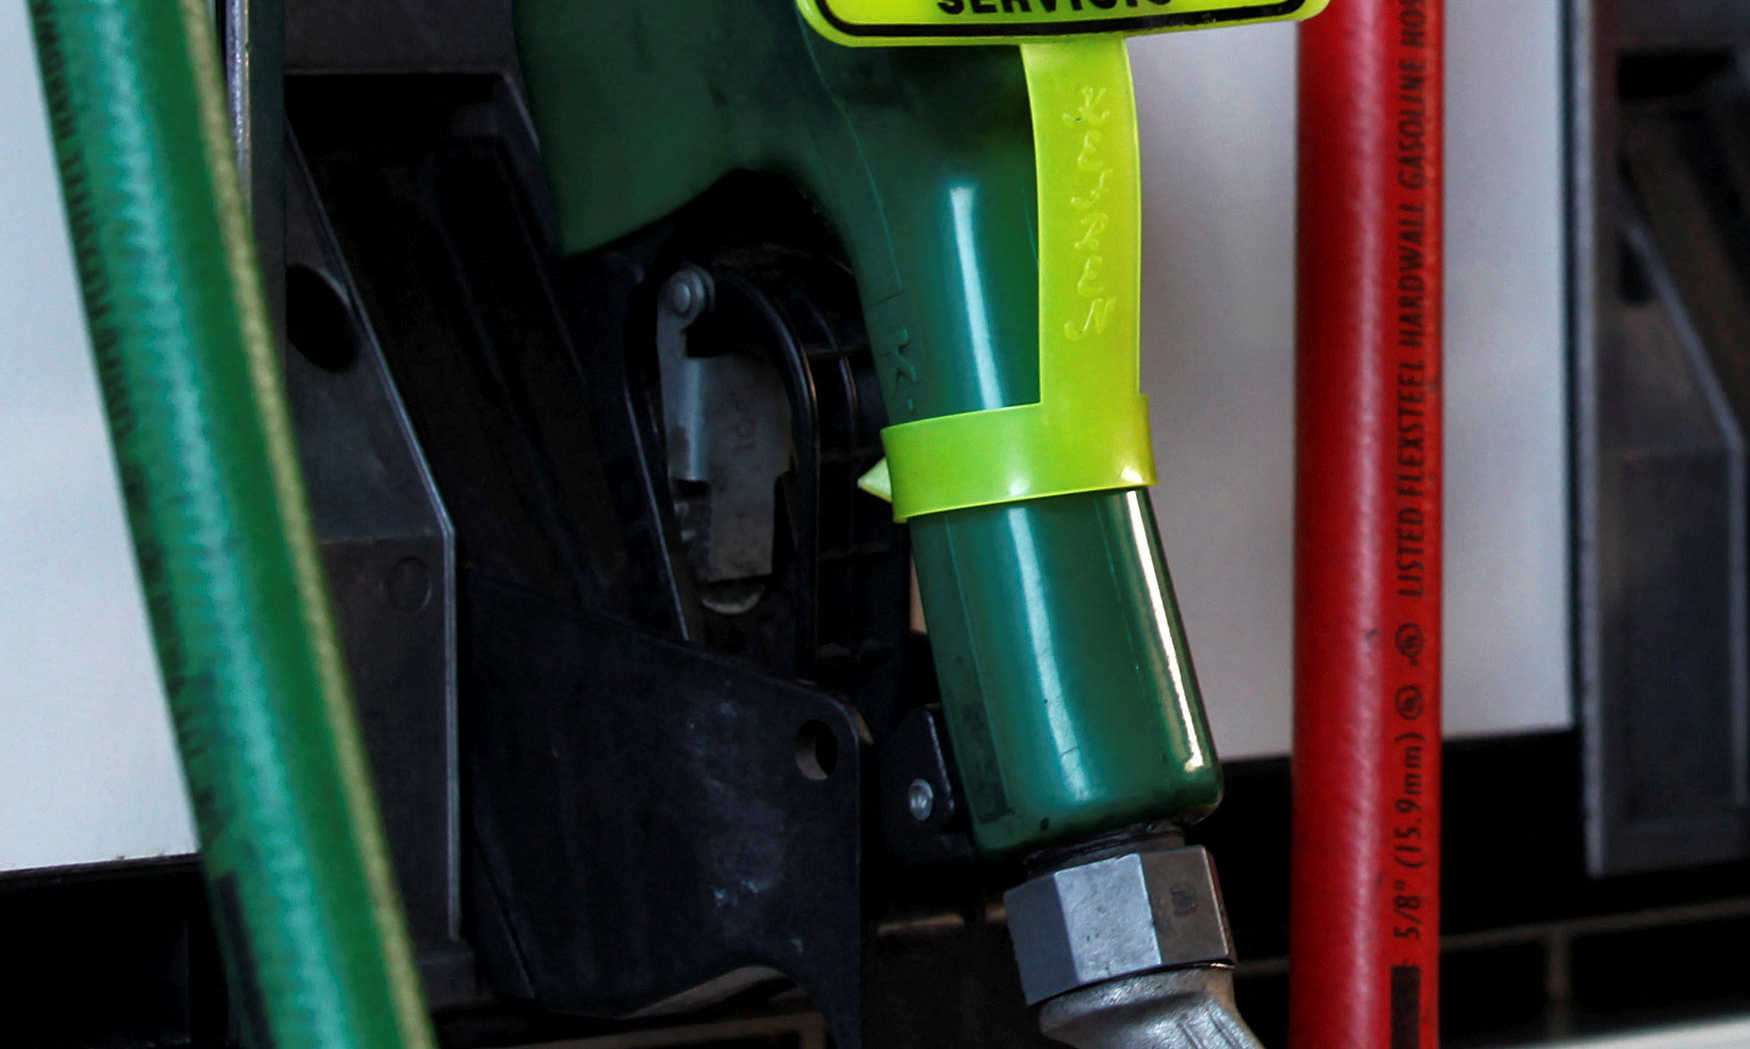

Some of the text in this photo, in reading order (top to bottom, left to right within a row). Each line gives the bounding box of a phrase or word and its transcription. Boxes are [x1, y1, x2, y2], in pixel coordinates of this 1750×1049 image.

[1398, 57, 1426, 191] GASOLINE
[1398, 203, 1425, 348] HARDWALL
[1397, 359, 1425, 498] FLEXSTEEL
[1397, 506, 1425, 597] LISTED
[1394, 731, 1427, 869] (15.9mm)
